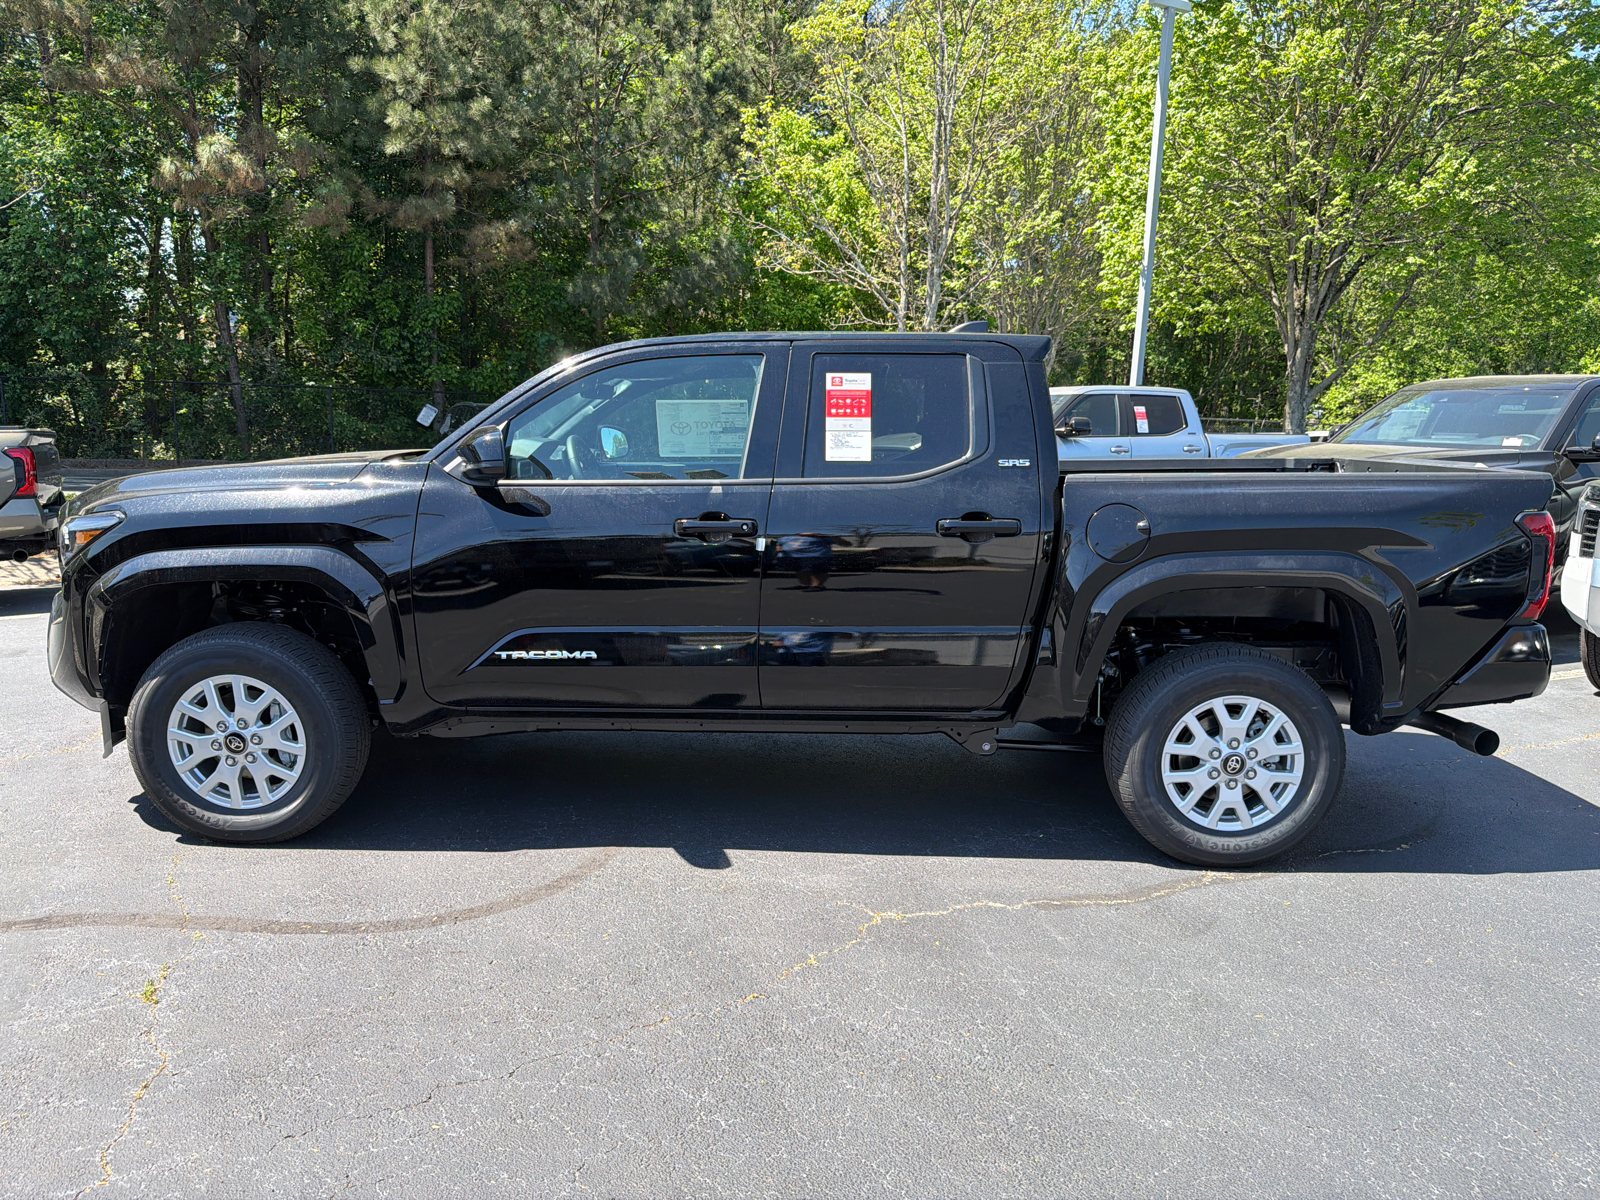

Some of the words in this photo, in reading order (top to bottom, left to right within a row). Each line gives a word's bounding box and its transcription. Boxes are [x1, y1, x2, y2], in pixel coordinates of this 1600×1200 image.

[694, 421, 735, 429] TOYOTA
[998, 459, 1030, 467] SR5
[494, 651, 597, 660] TACOMA
[153, 770, 221, 829] Firestone
